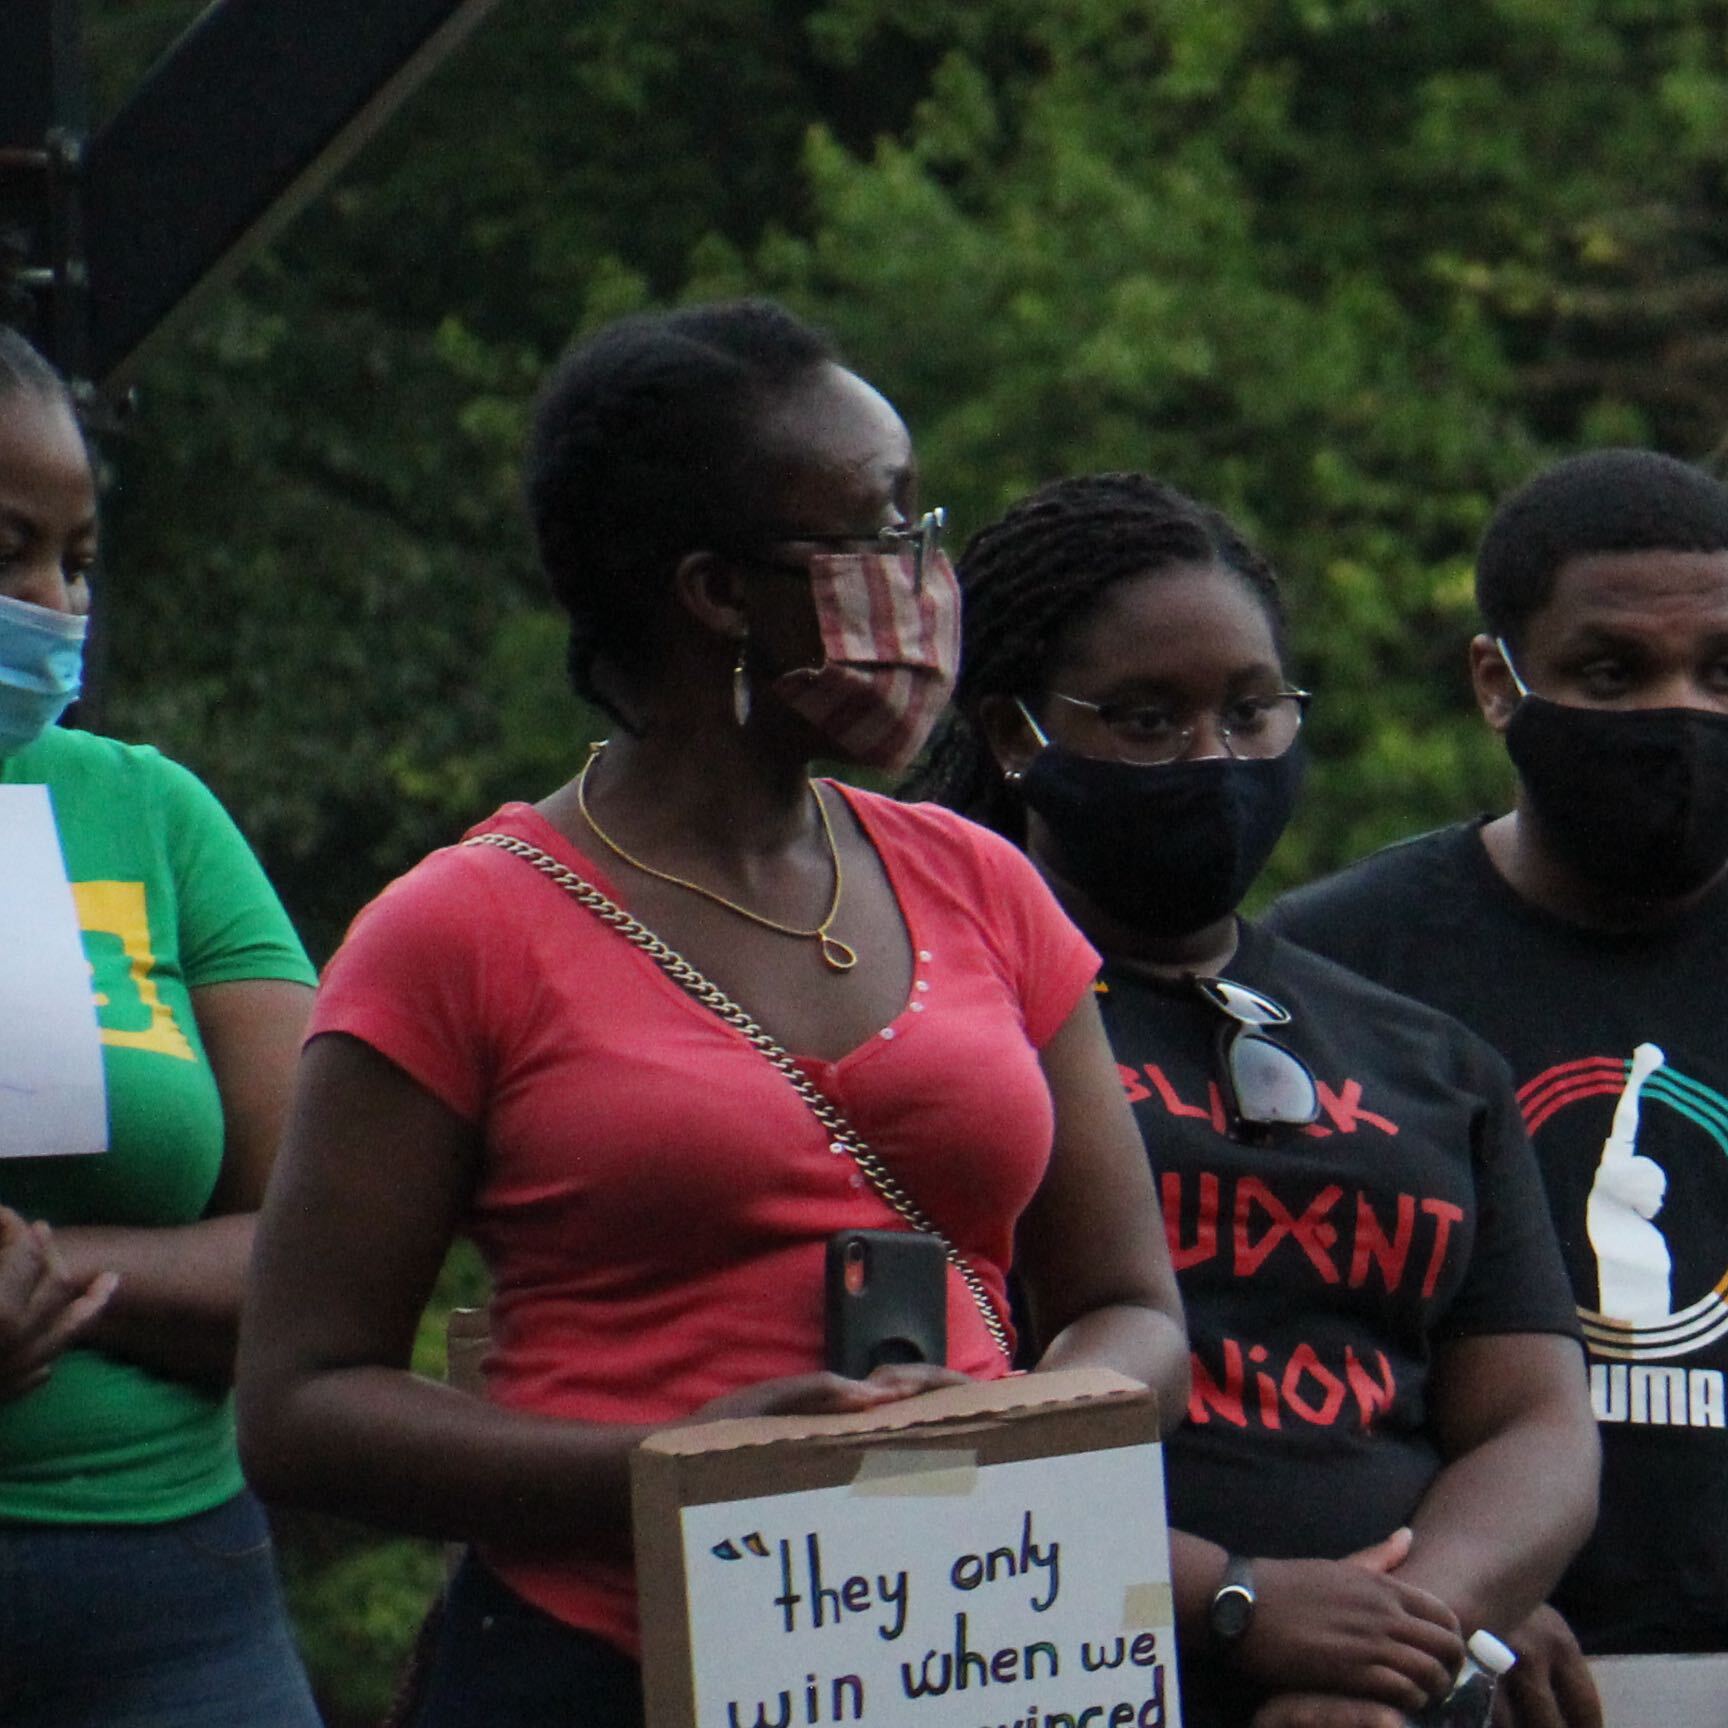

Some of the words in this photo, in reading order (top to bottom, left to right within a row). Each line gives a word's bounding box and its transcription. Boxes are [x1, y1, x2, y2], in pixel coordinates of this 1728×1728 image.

[1116, 1062, 1399, 1138] BLK
[1161, 1172, 1464, 1299] UDENT
[1189, 1338, 1395, 1431] NION
[1591, 1366, 1727, 1429] UMA
[951, 1510, 1061, 1612] only
[902, 1613, 1060, 1700] when
[1082, 1632, 1158, 1673] we
